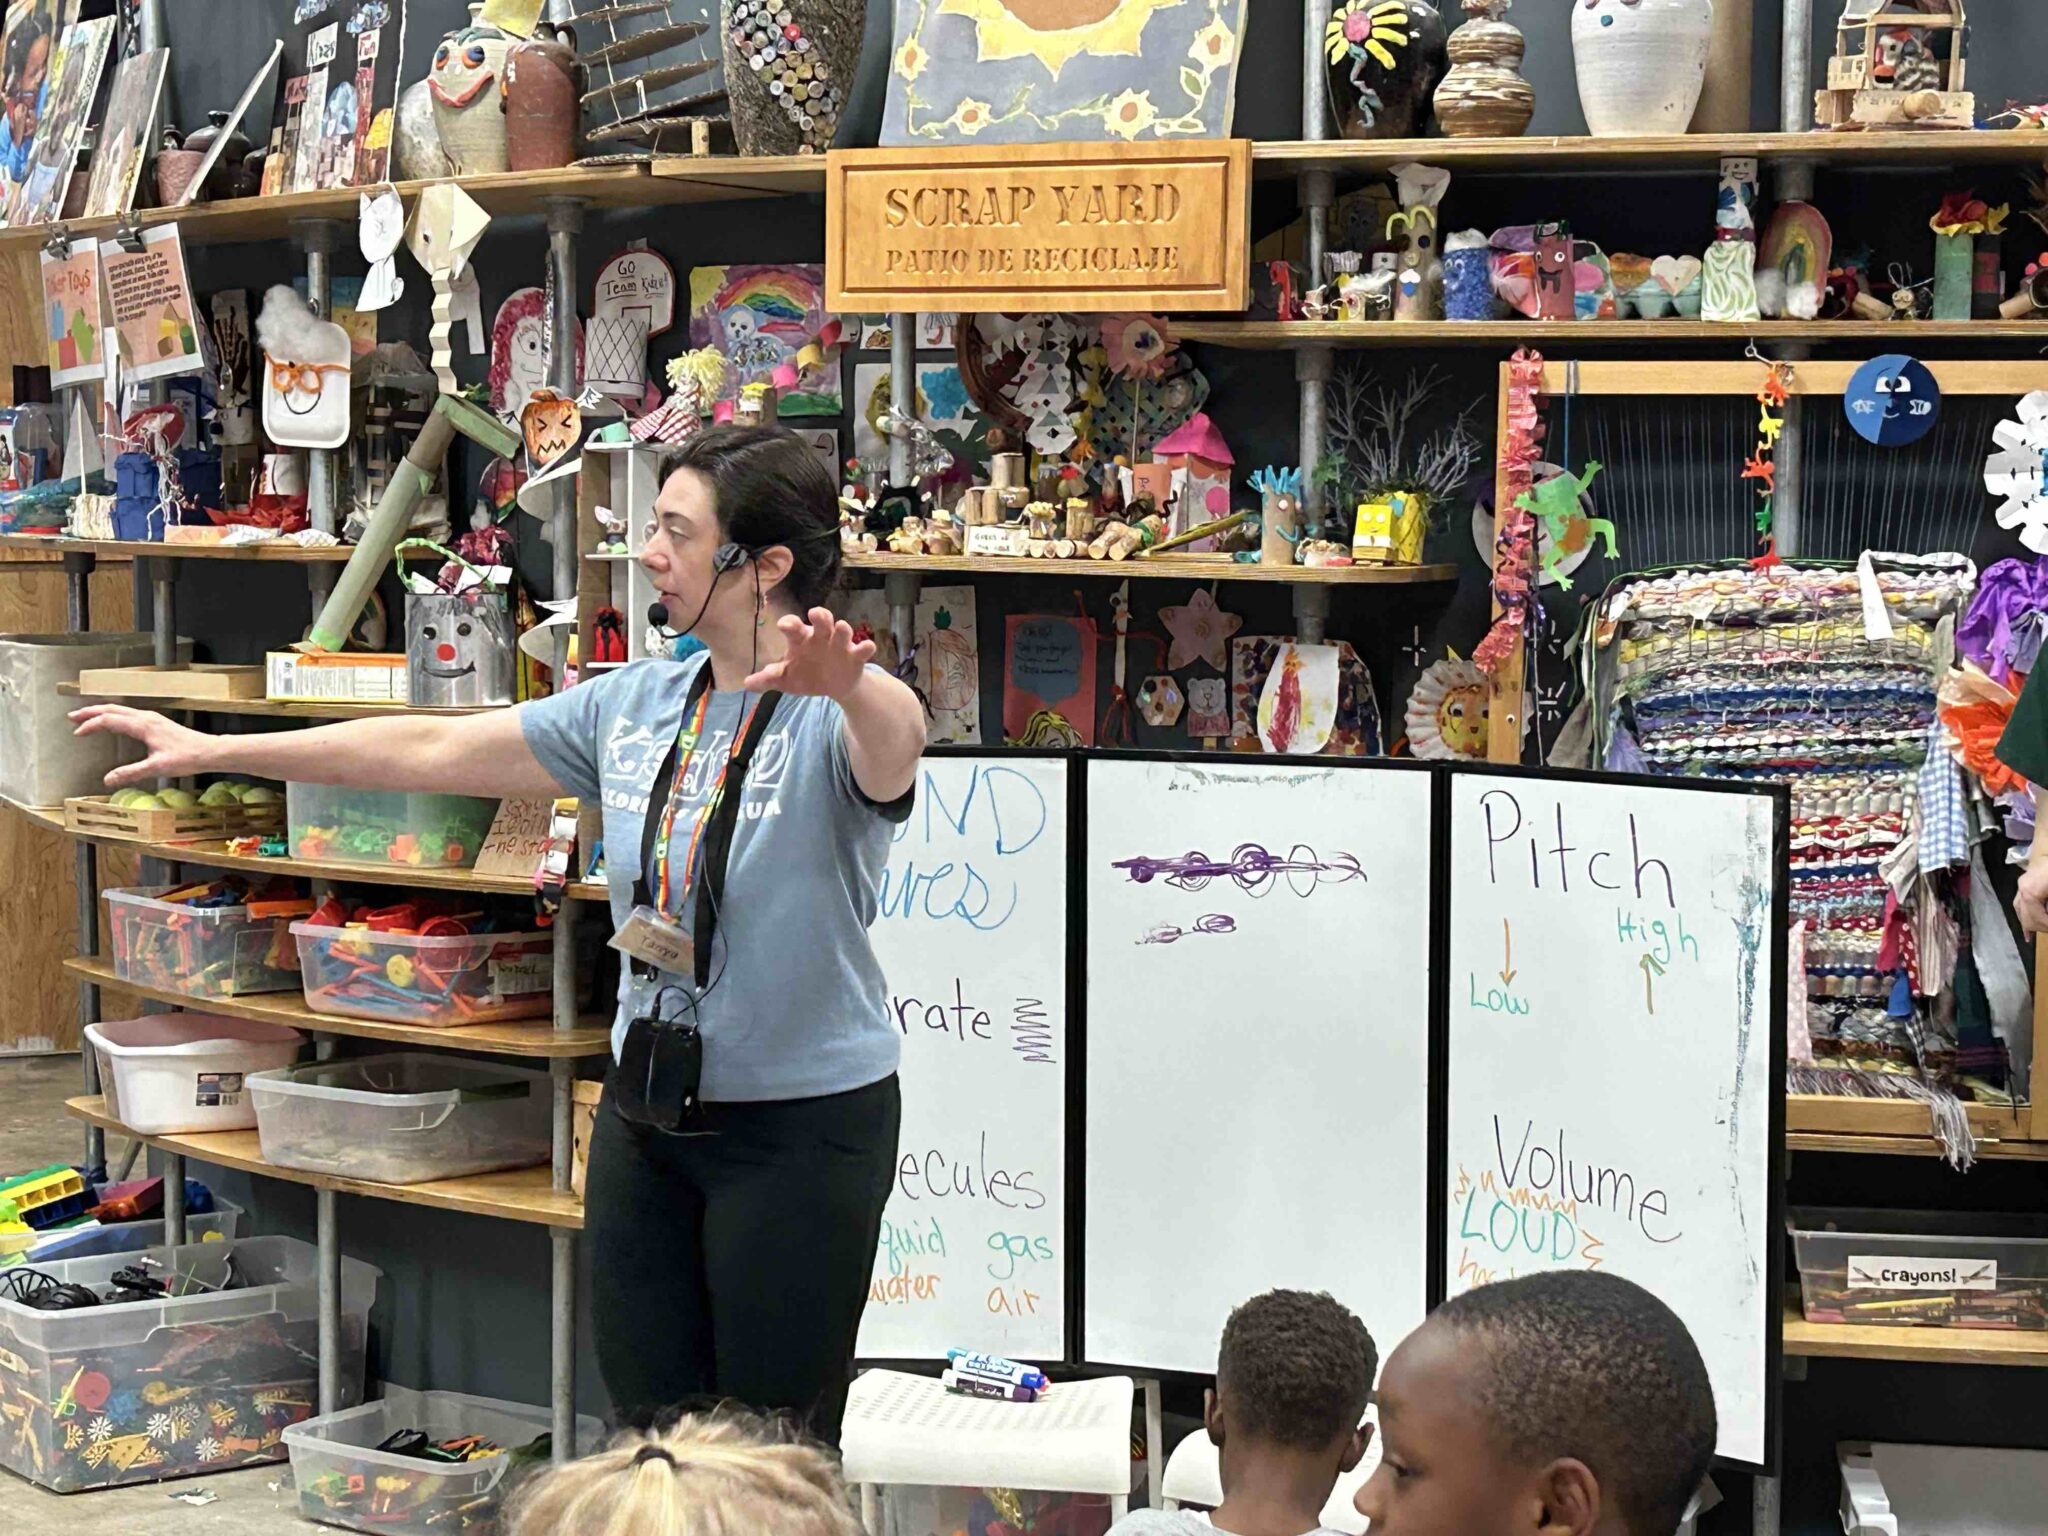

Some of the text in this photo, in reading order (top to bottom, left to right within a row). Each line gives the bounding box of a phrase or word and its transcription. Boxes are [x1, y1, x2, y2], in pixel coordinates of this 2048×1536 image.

[885, 183, 1182, 228] SCRAP YARD
[601, 280, 638, 296] Team
[884, 246, 1179, 275] PATIO DE RECICLAJE
[1480, 790, 1676, 908] Pitch
[1617, 907, 1698, 965] High
[884, 977, 992, 1042] rate
[1471, 972, 1530, 1015] Low
[899, 1131, 1046, 1209] ecules
[1494, 1114, 1683, 1243] Volume
[879, 1216, 1054, 1280] quid gas
[1460, 1186, 1576, 1261] LOUD
[987, 1286, 1041, 1317] air
